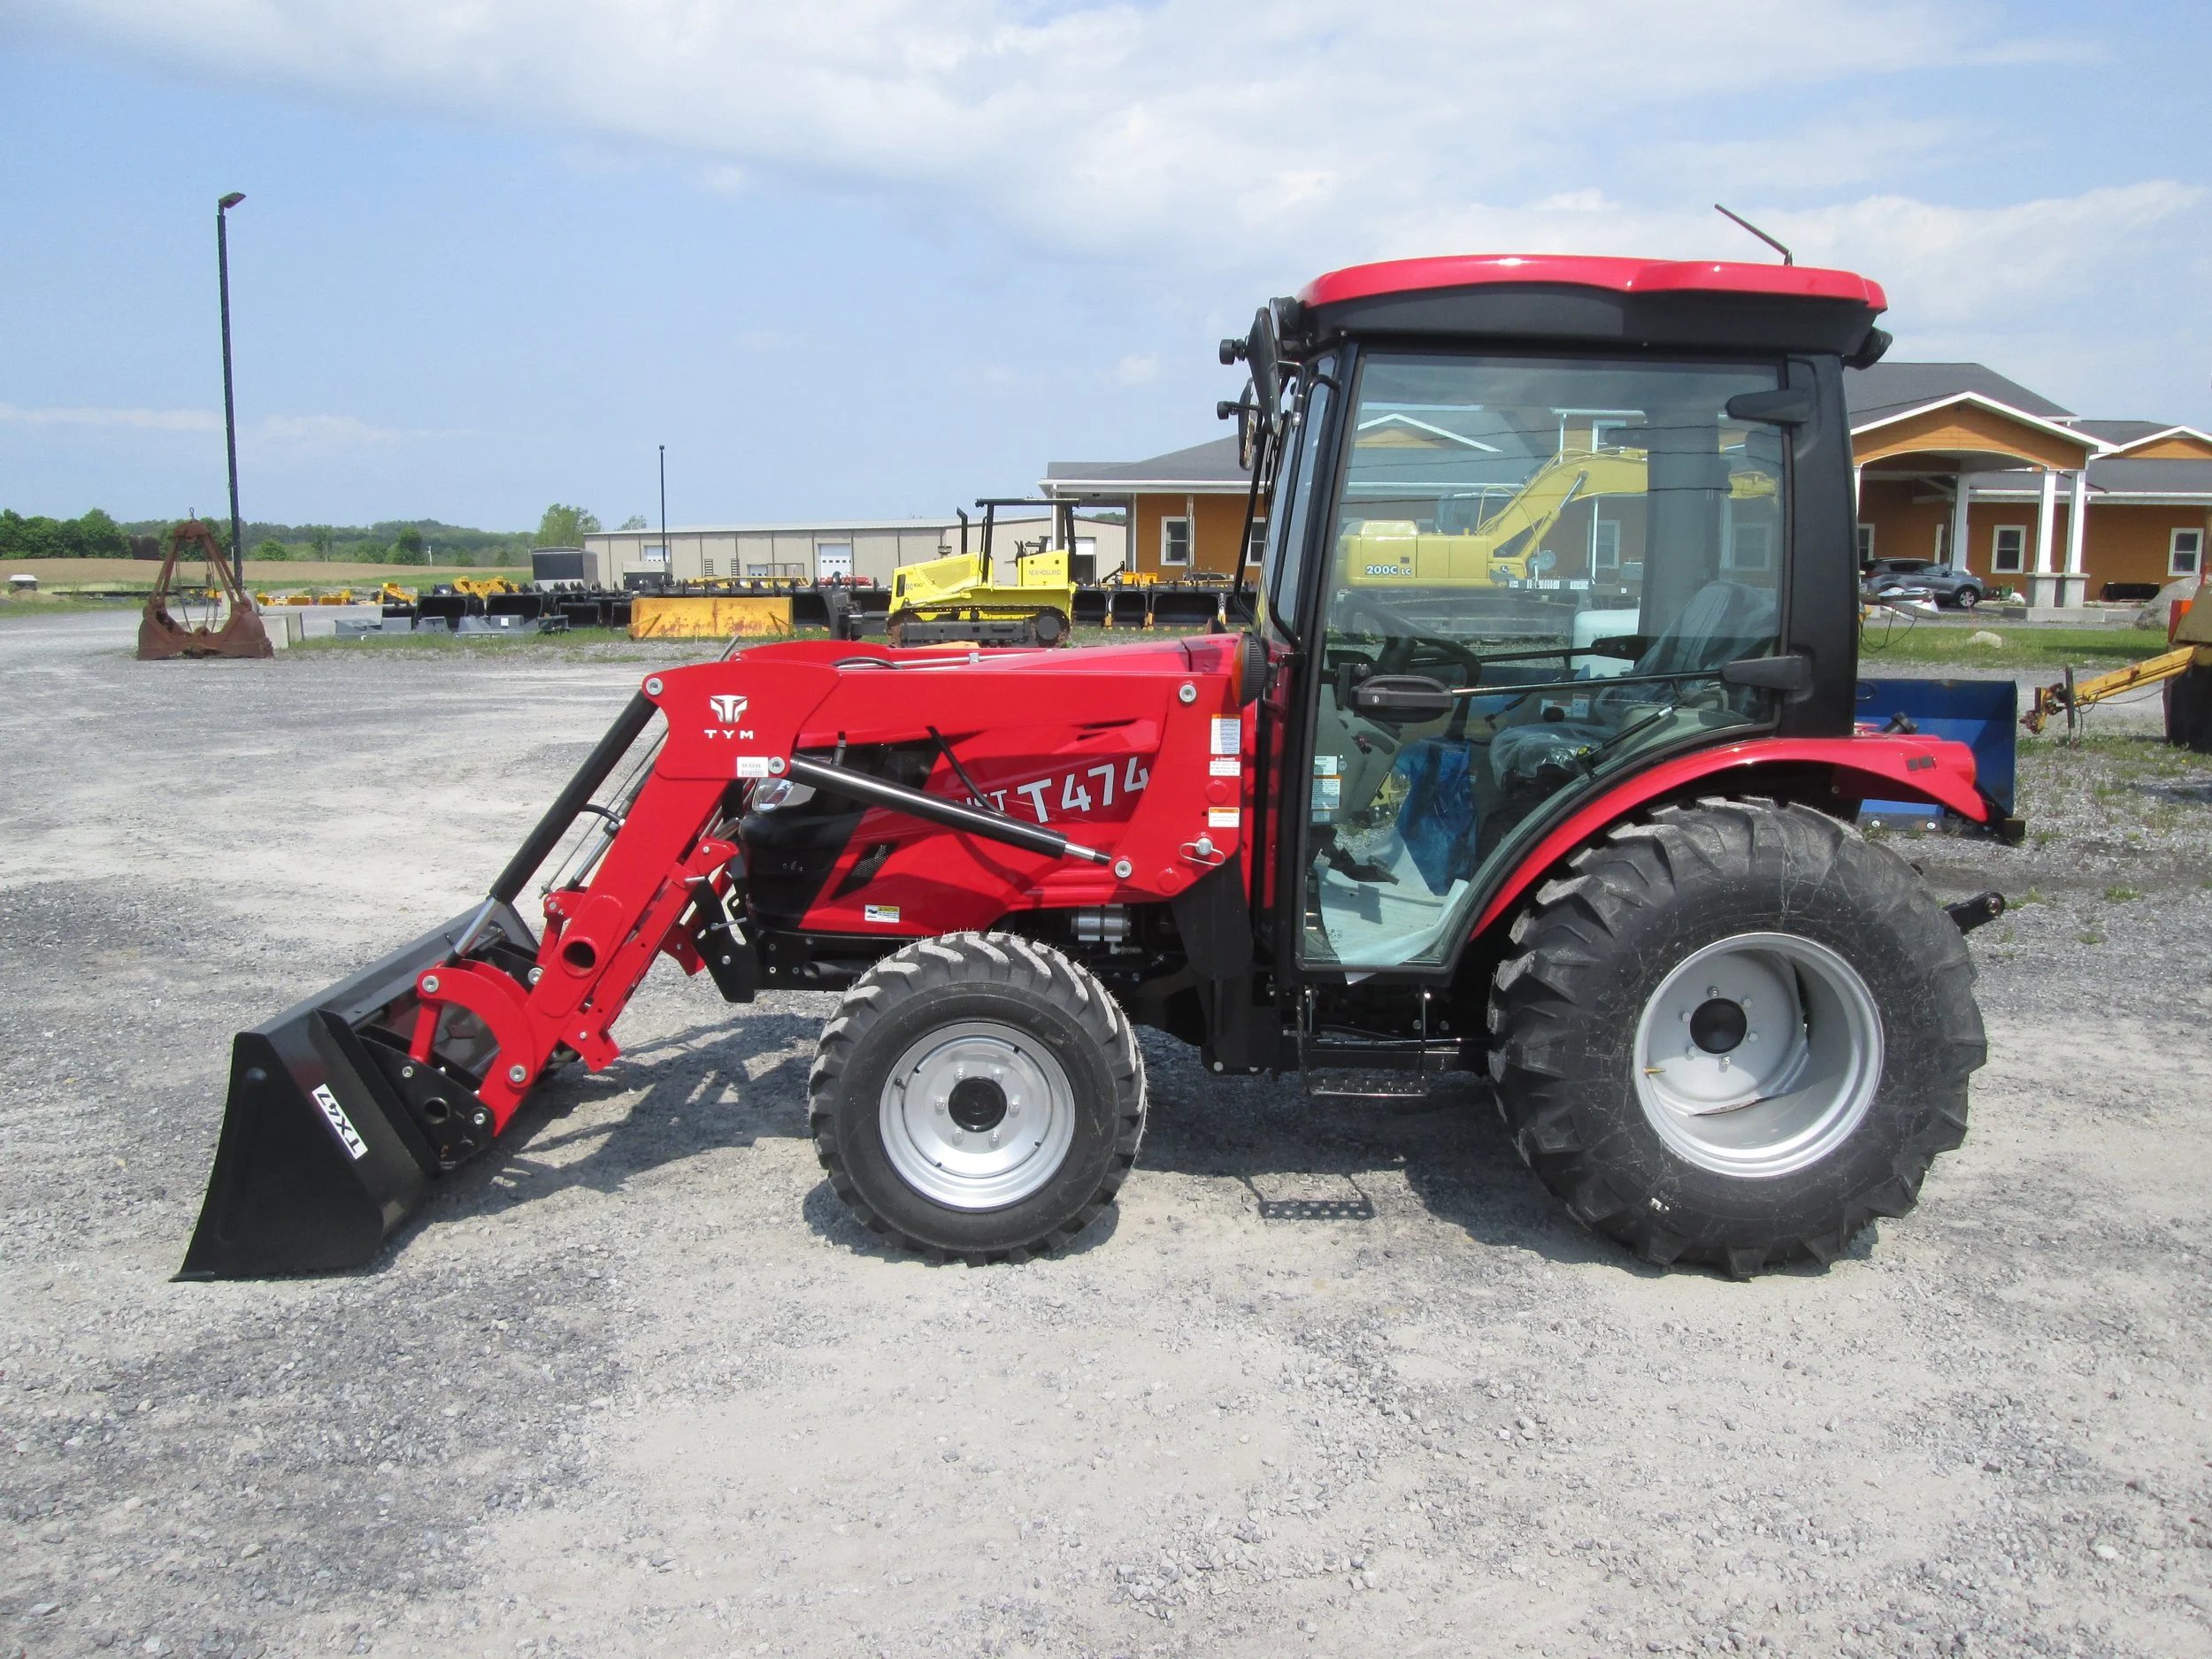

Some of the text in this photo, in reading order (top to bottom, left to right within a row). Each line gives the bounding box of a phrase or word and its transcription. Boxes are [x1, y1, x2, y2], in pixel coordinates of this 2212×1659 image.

[1365, 565, 1398, 575] 200C
[704, 729, 754, 740] TYM
[1017, 756, 1150, 824] T474
[317, 1093, 360, 1154] TX47
